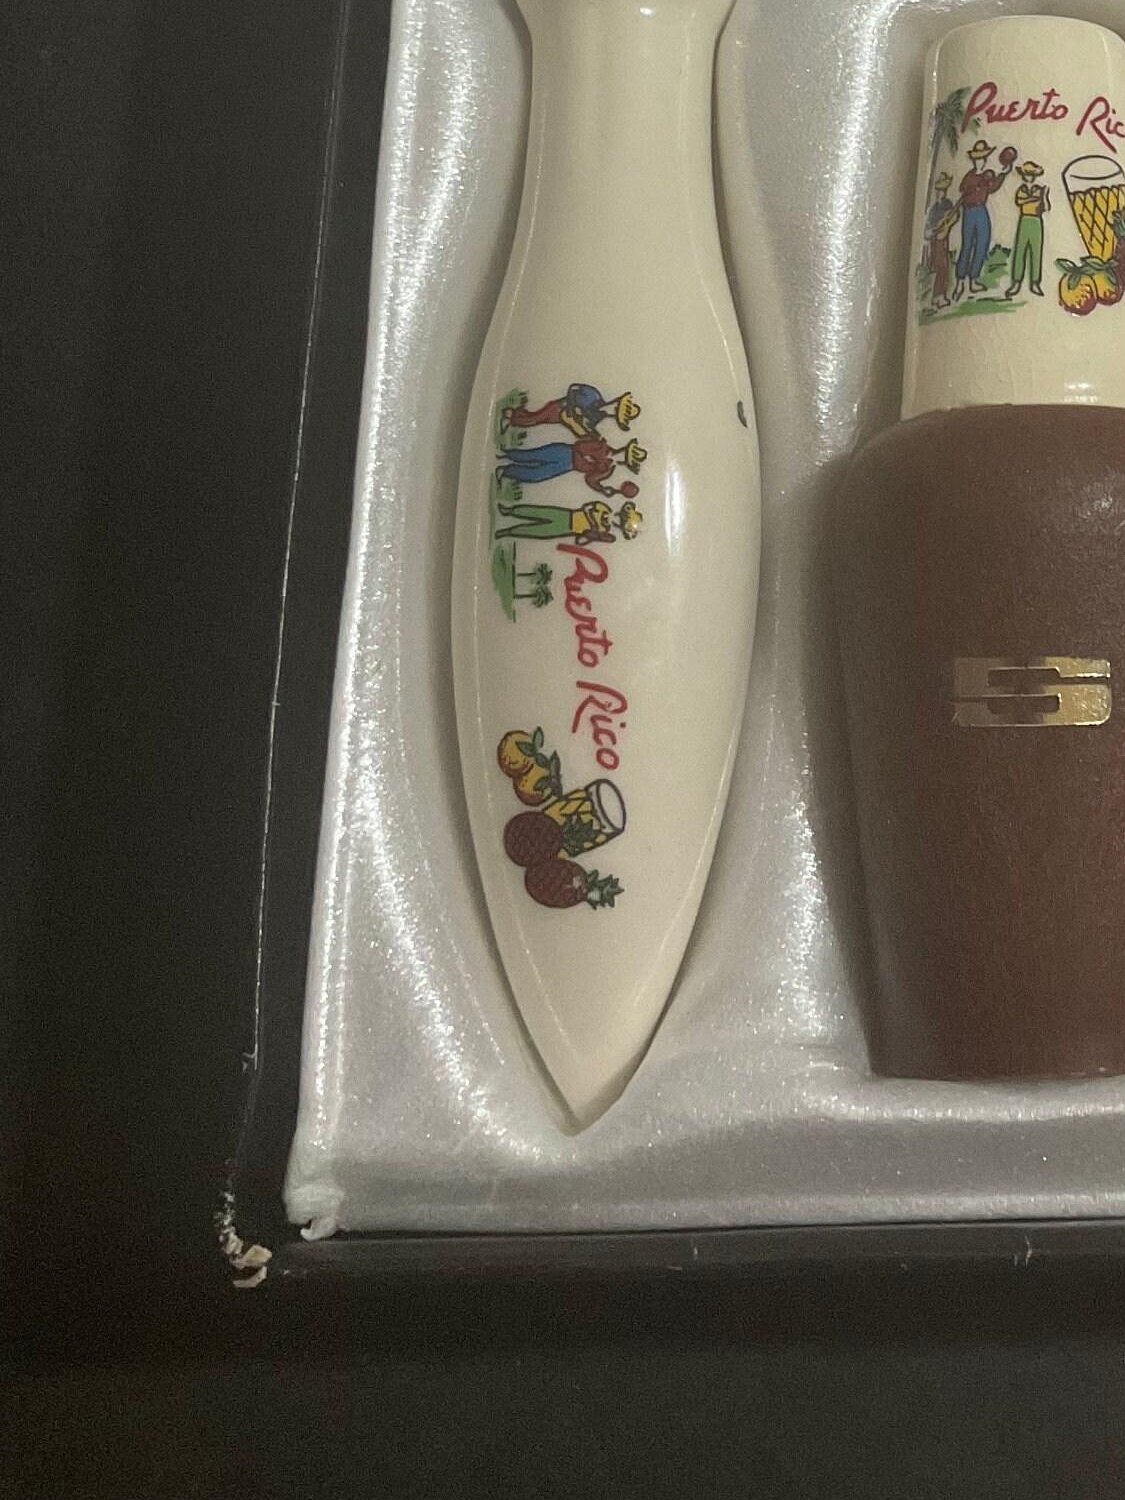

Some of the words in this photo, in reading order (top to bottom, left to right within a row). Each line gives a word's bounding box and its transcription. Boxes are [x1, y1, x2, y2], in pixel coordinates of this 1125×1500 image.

[960, 81, 1068, 134] Puerto
[556, 542, 613, 669] Puerto
[571, 680, 628, 771] Rico
